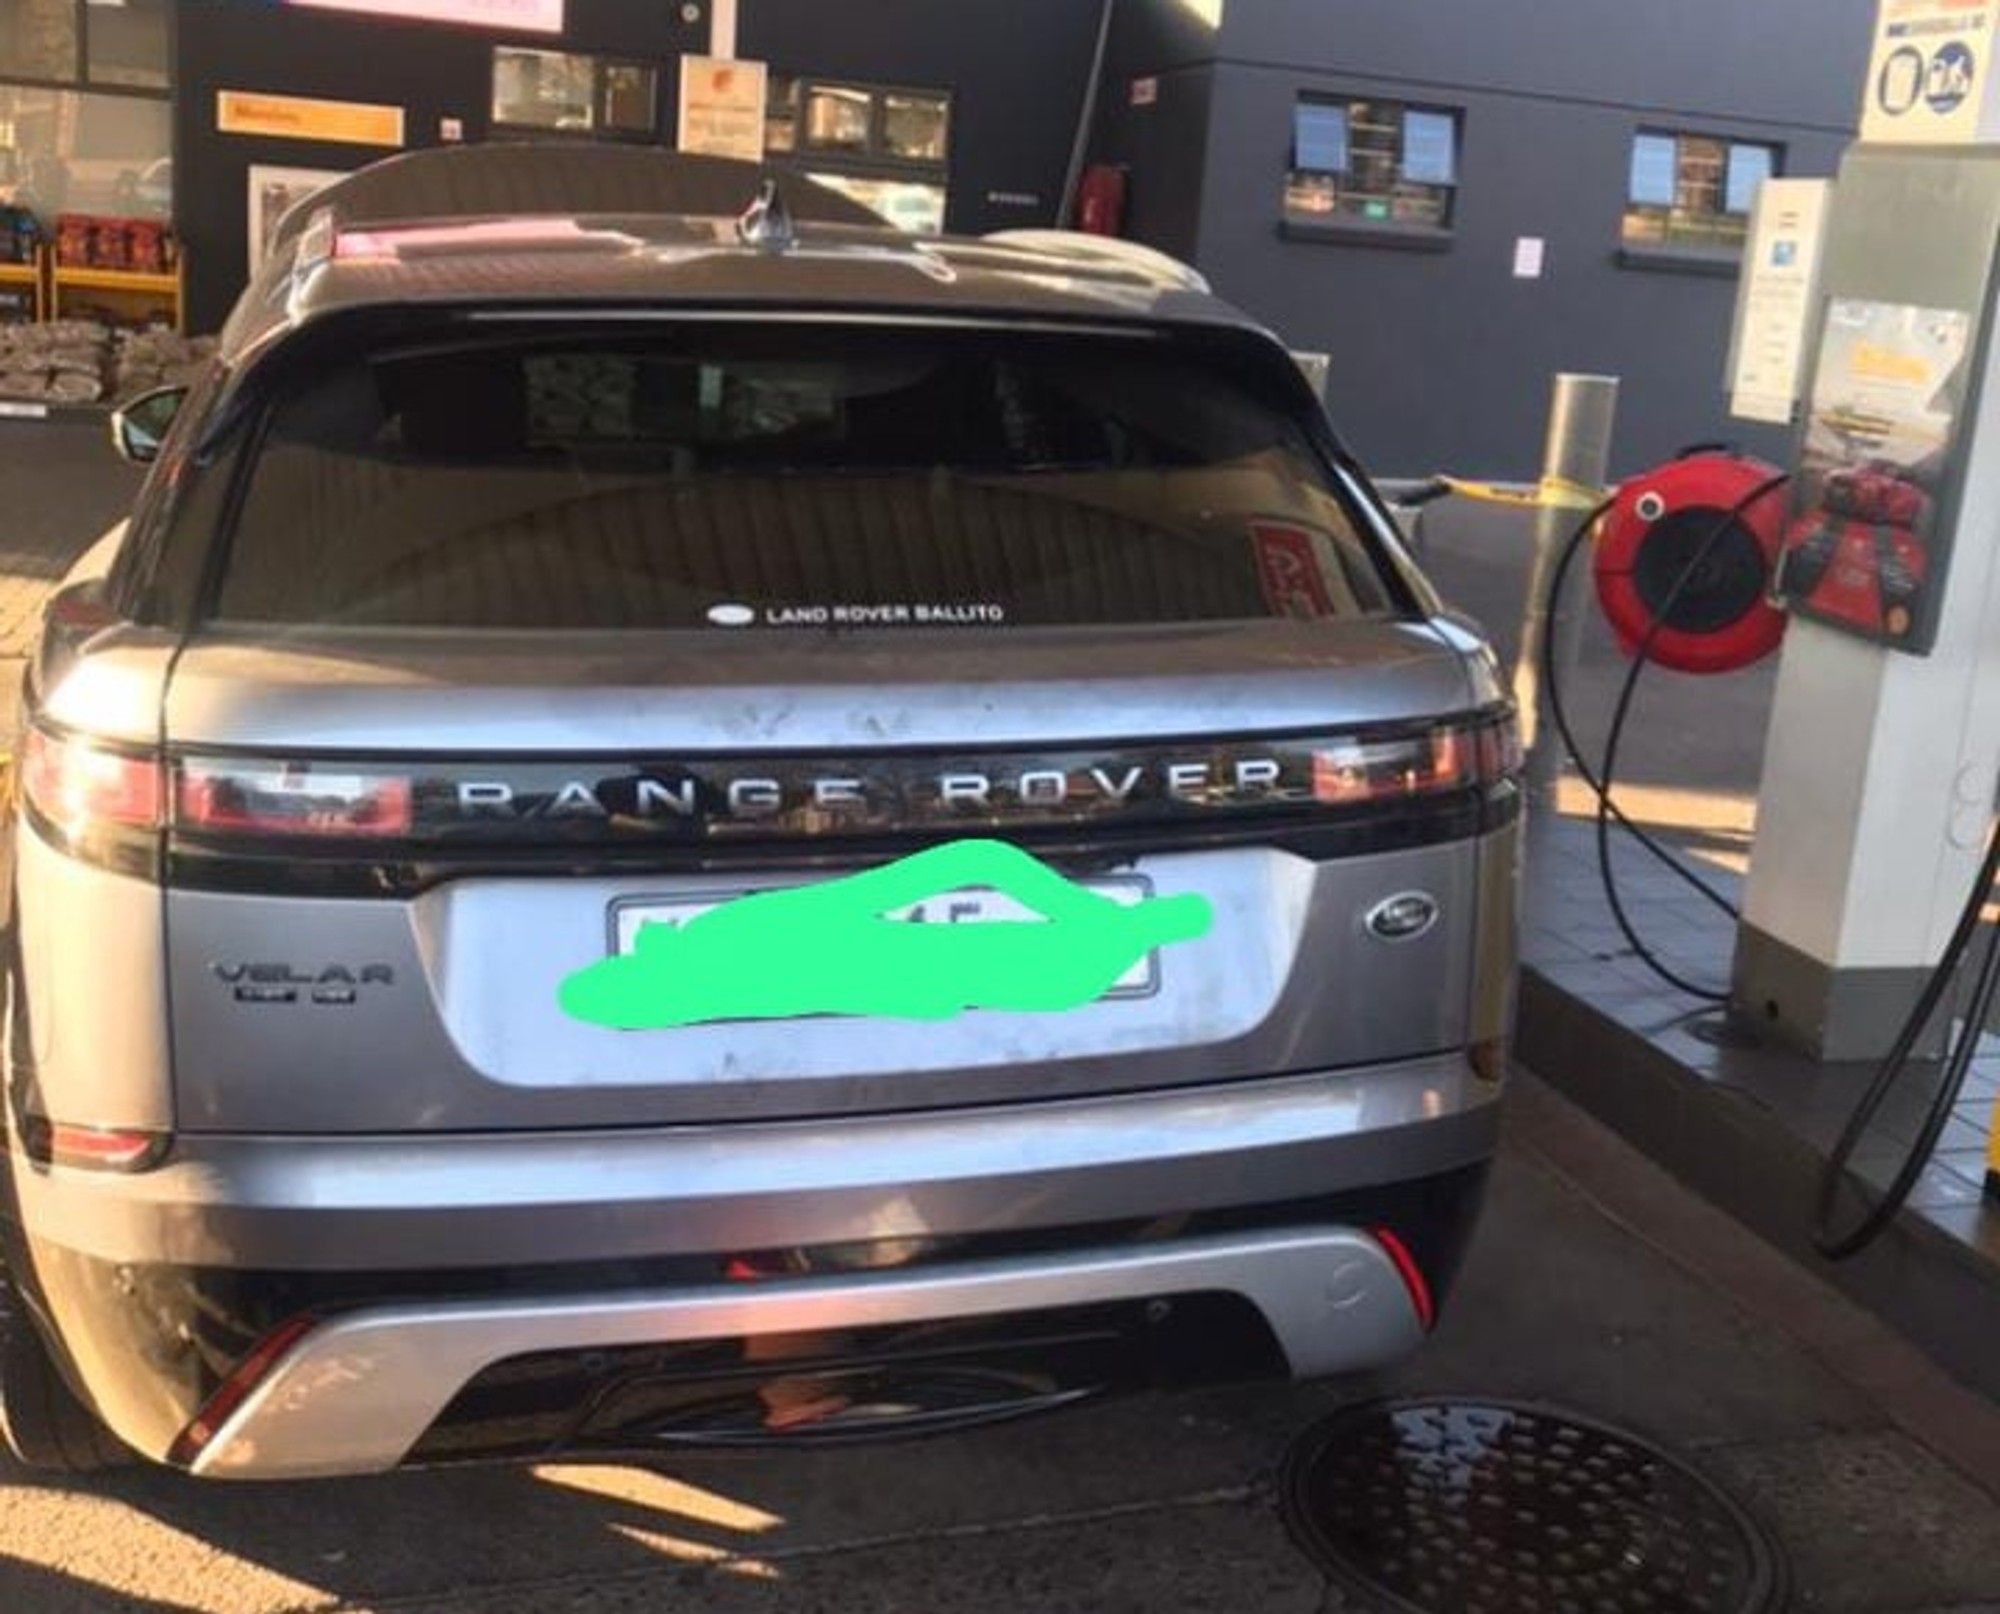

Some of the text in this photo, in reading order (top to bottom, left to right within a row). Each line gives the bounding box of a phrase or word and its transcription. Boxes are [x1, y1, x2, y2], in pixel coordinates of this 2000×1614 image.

[766, 603, 1005, 624] LAND ROVER BALLITO
[456, 758, 1281, 817] RANGE ROVER
